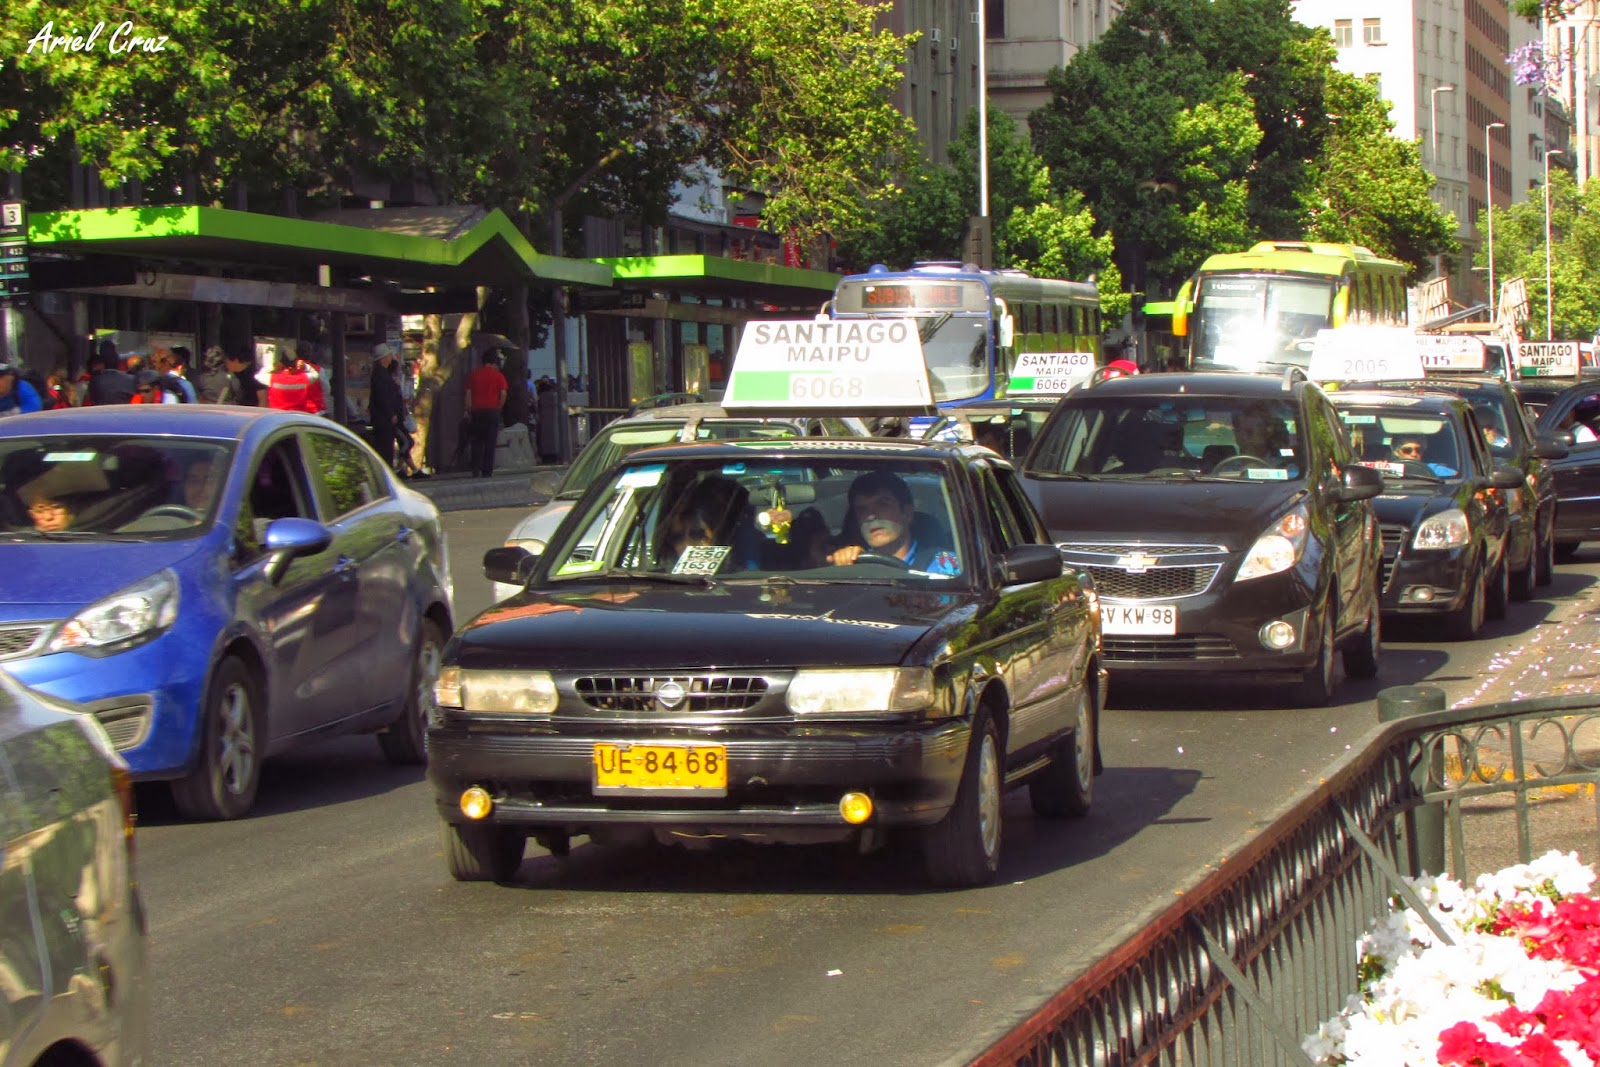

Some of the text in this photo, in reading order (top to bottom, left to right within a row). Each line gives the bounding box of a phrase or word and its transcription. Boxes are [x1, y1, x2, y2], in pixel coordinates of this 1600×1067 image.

[9, 211, 16, 222] 3
[754, 322, 908, 345] SANTIAGO
[787, 346, 870, 363] MAIPU
[1520, 345, 1572, 357] SANTIAGO
[1022, 355, 1089, 366] SANTIAGO
[1531, 357, 1562, 366] MAIPU
[1035, 367, 1072, 375] MAIPU
[1344, 359, 1389, 375] 2005
[791, 376, 863, 399] 6068
[1036, 379, 1068, 390] 6066
[687, 550, 726, 559] 1550
[682, 561, 718, 570] 1650
[1123, 607, 1145, 625] KW
[1152, 608, 1173, 624] 98
[600, 749, 633, 774] UE
